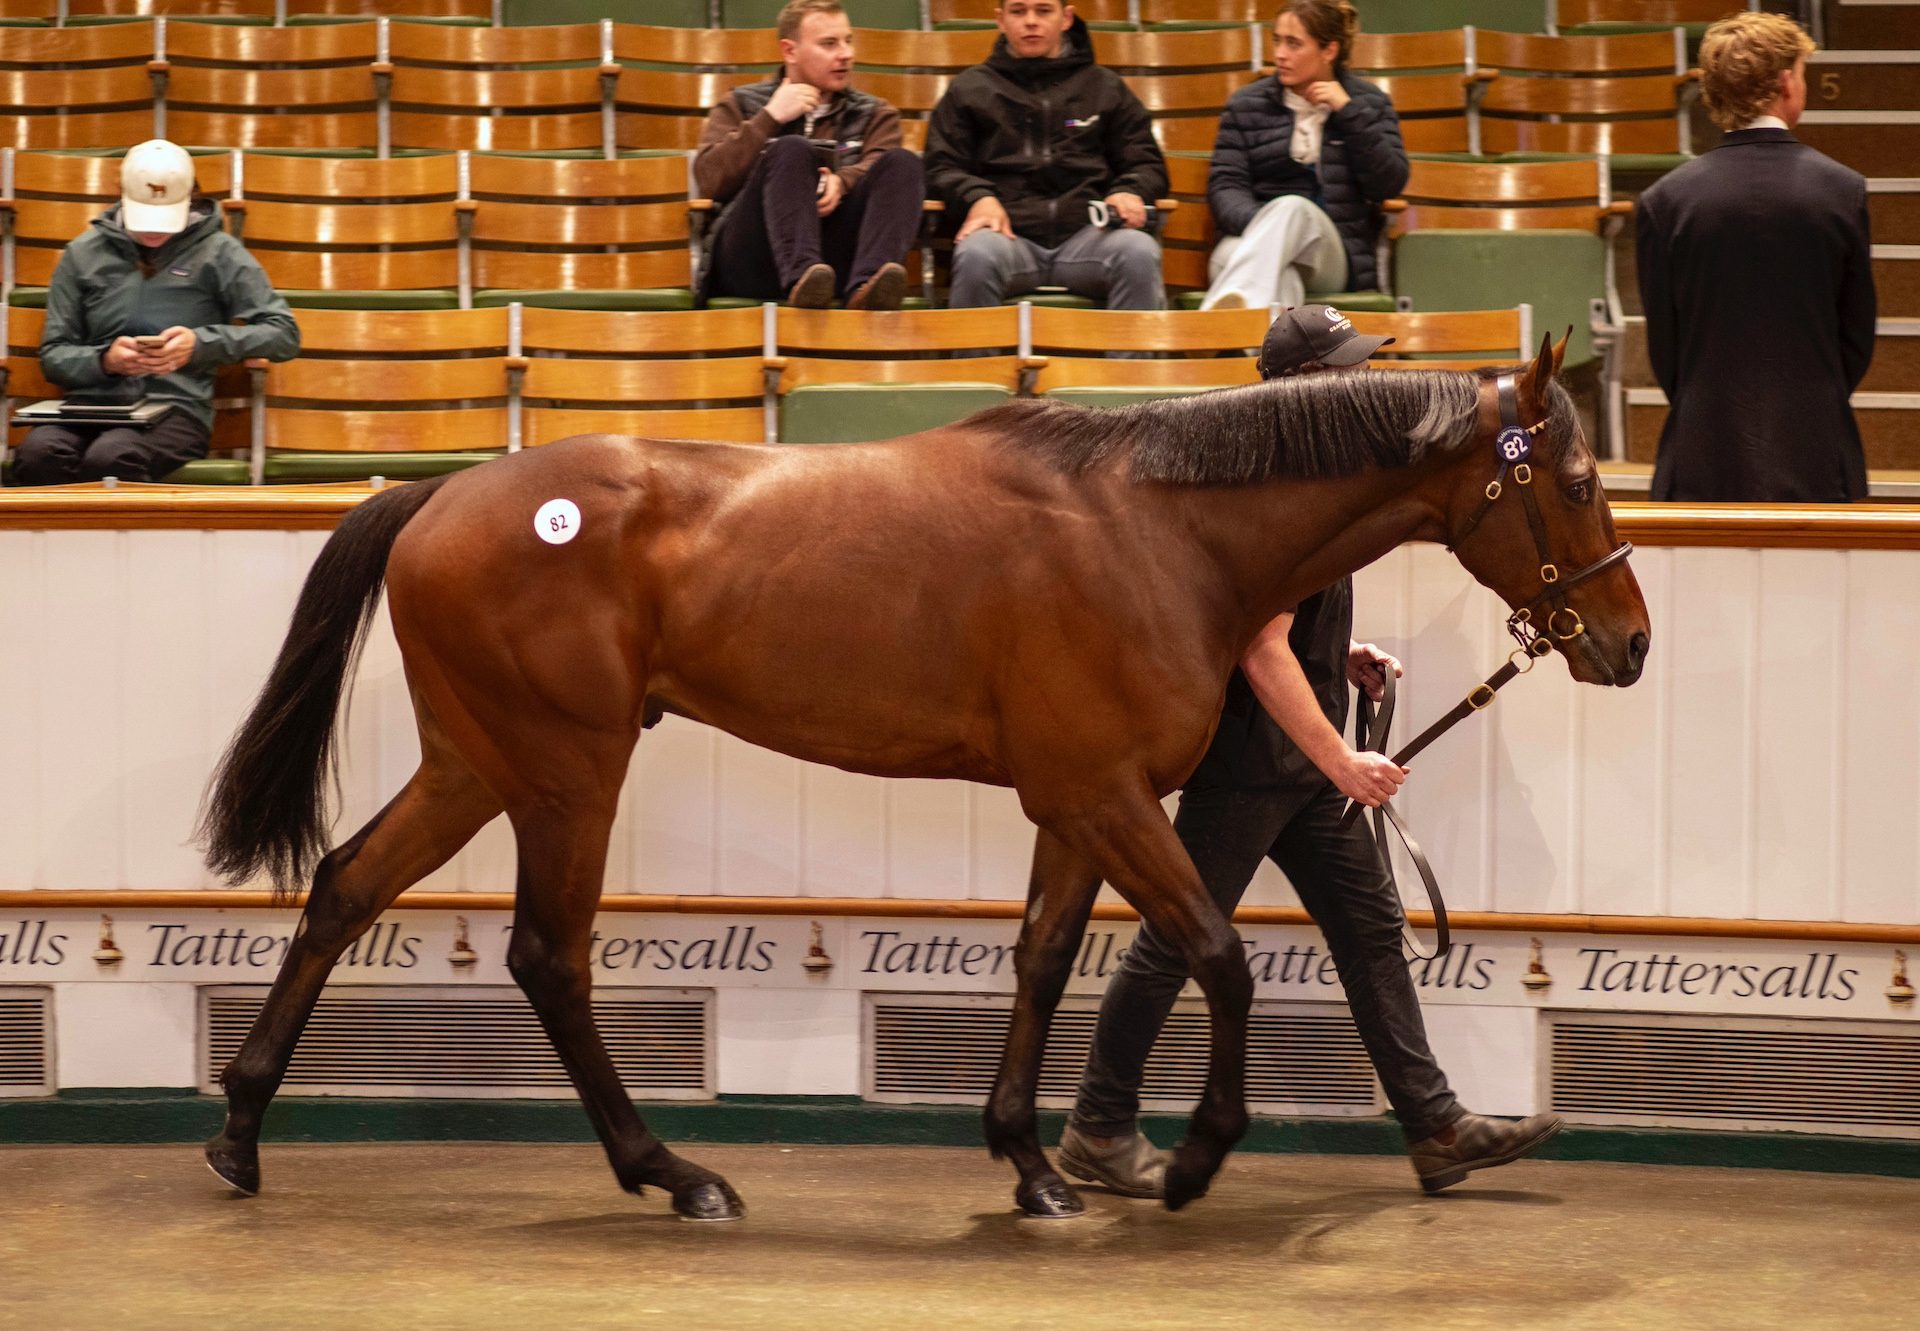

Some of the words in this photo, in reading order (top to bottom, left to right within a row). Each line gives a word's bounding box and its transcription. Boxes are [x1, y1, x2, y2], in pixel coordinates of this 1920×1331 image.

[1821, 73, 1841, 100] 5
[1503, 435, 1529, 460] 82
[550, 514, 568, 532] 82
[1577, 947, 1860, 1001] Tattersalls
